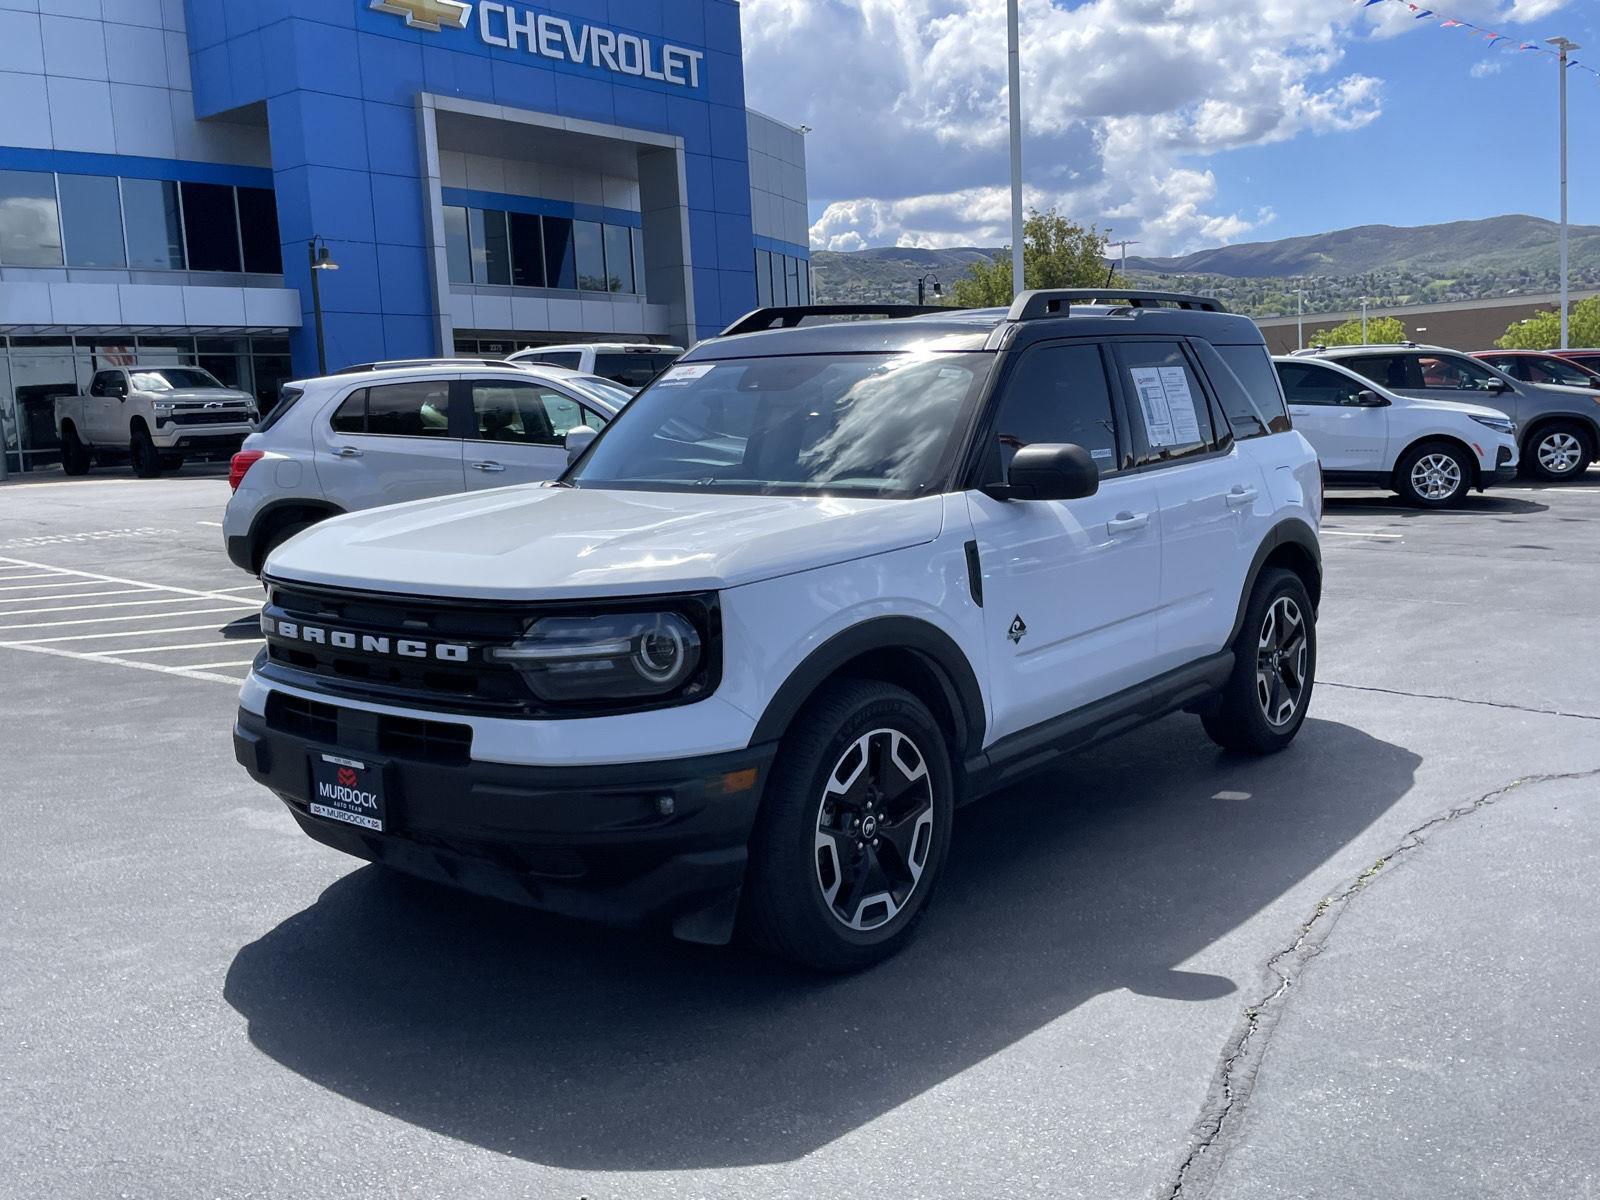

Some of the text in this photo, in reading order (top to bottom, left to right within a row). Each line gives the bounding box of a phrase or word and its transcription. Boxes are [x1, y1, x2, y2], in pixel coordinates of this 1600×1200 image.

[479, 1, 704, 88] CHEVROLET
[278, 621, 469, 662] BRONCO
[319, 781, 378, 809] MURDOCK
[333, 801, 362, 813] AUTO TEAM
[326, 808, 366, 826] MURDOCK
